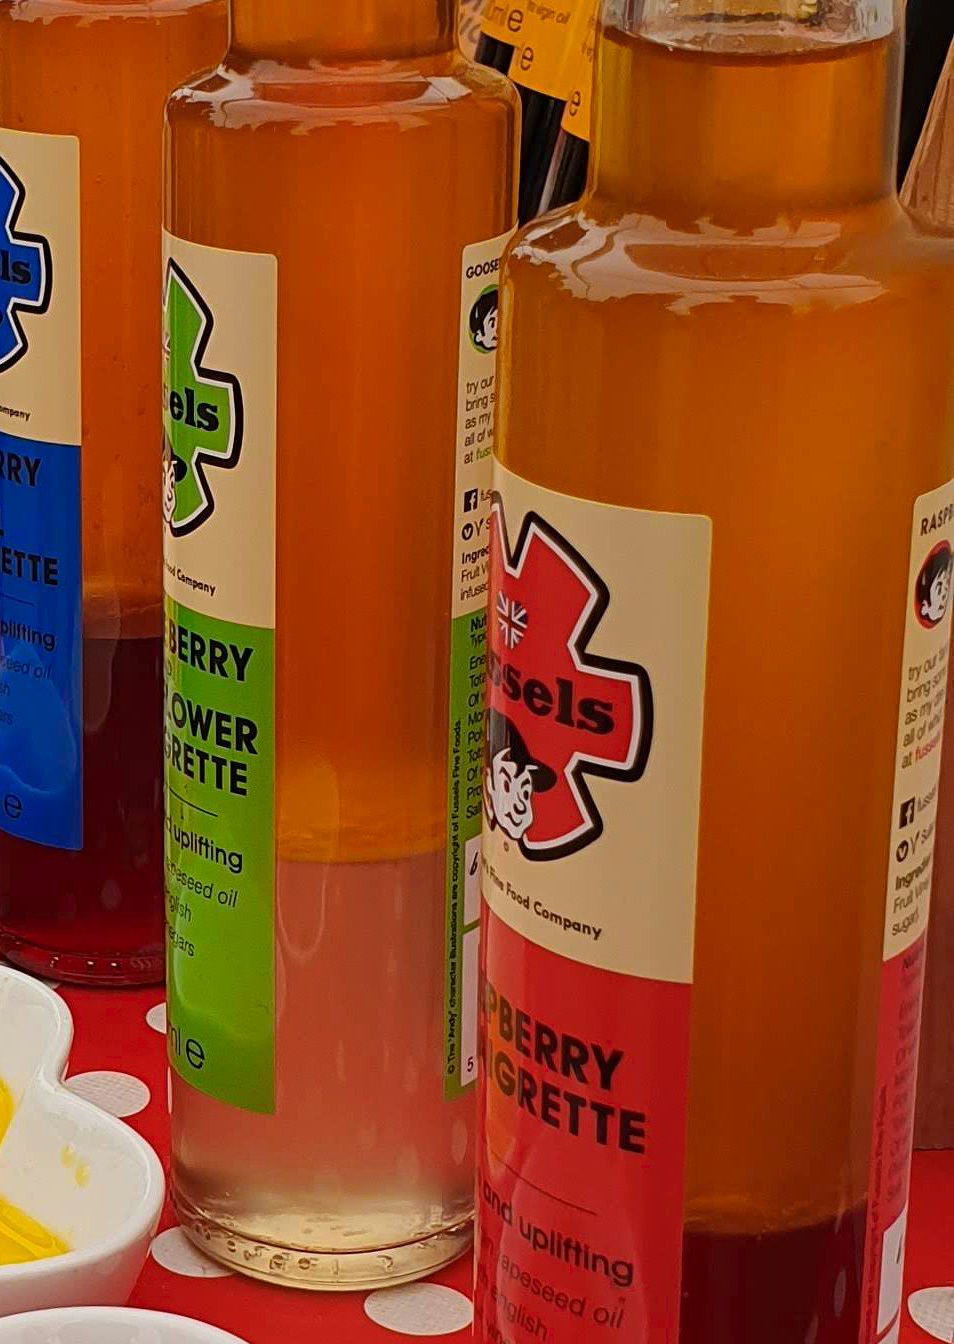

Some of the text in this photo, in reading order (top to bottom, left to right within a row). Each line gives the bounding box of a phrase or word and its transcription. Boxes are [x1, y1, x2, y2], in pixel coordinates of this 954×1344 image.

[176, 567, 217, 597] Company
[33, 664, 52, 680] oil
[173, 824, 244, 875] uplifting
[217, 888, 239, 909] oil
[506, 881, 531, 911] Food
[533, 900, 602, 941] Company
[483, 1181, 634, 1288] and uplifting
[593, 1302, 625, 1330] oil
